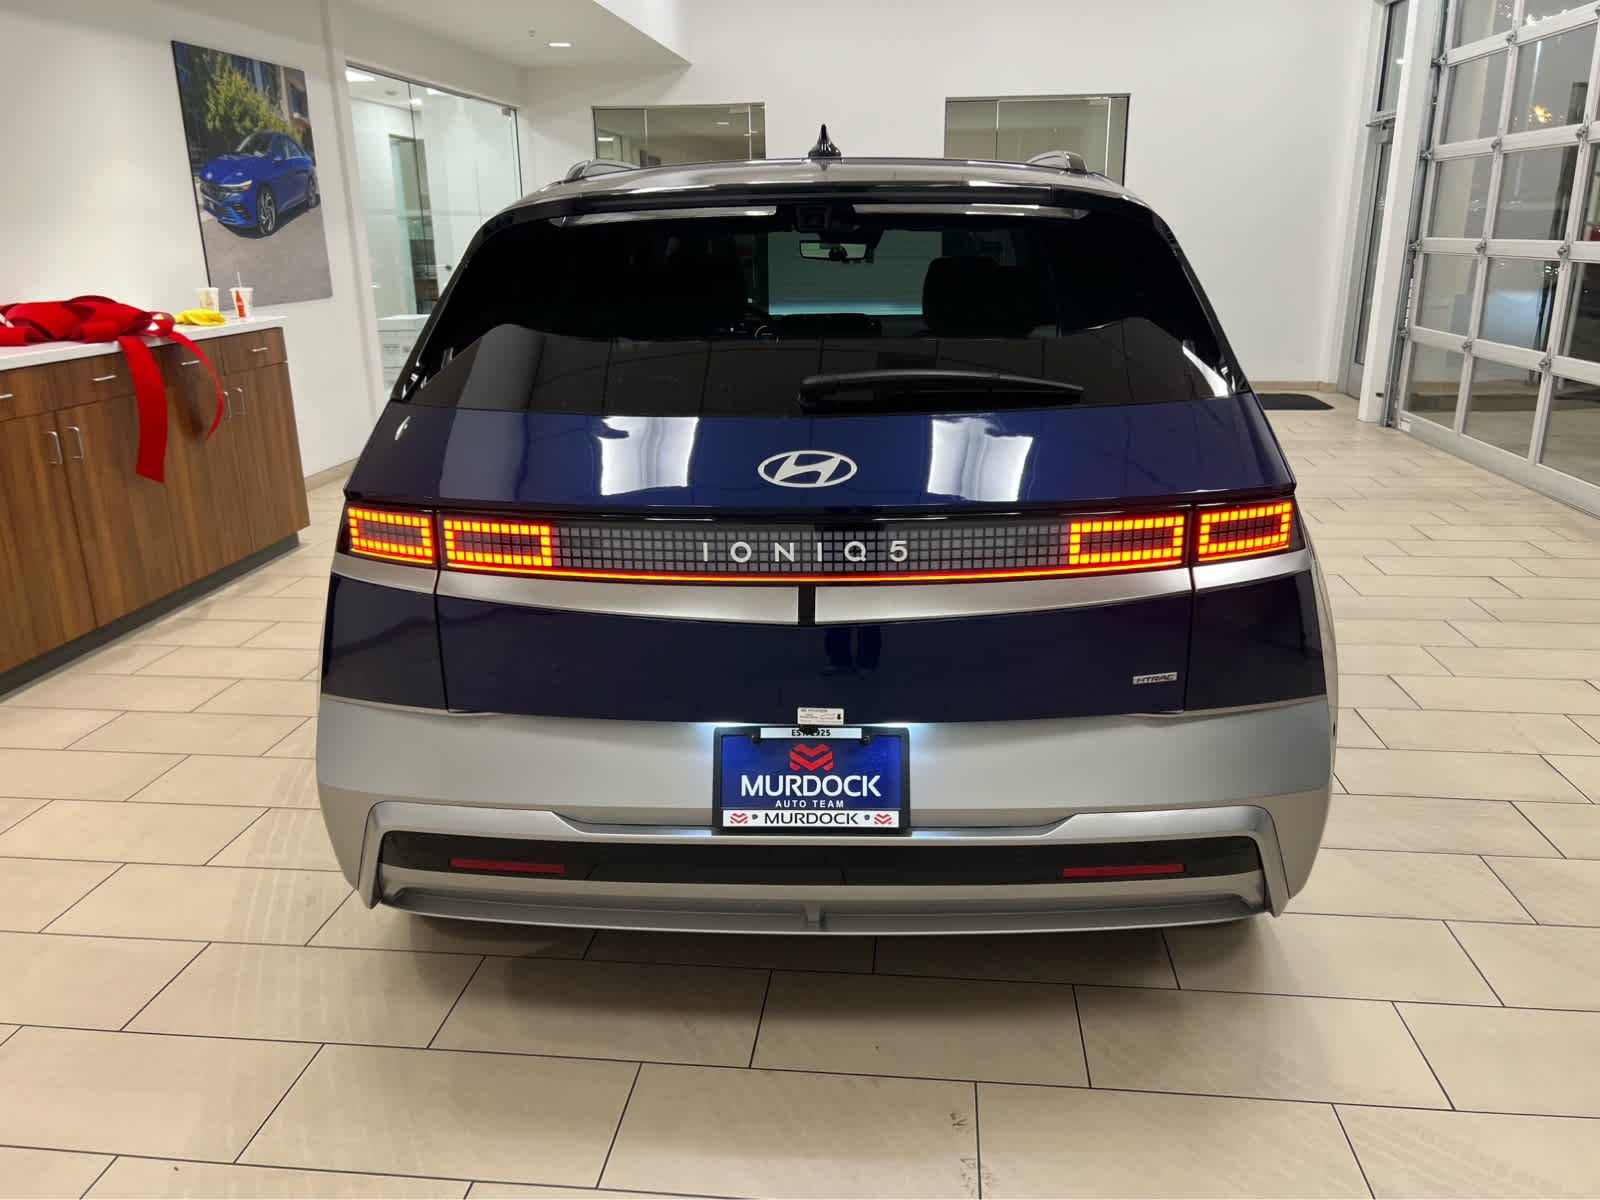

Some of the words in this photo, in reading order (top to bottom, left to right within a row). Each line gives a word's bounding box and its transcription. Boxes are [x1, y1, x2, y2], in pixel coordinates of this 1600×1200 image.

[702, 541, 866, 563] IONIQ
[741, 775, 881, 797] MURDOCK
[775, 799, 806, 808] AUTO
[812, 799, 844, 808] TEAM
[764, 812, 859, 825] MURDOCK
